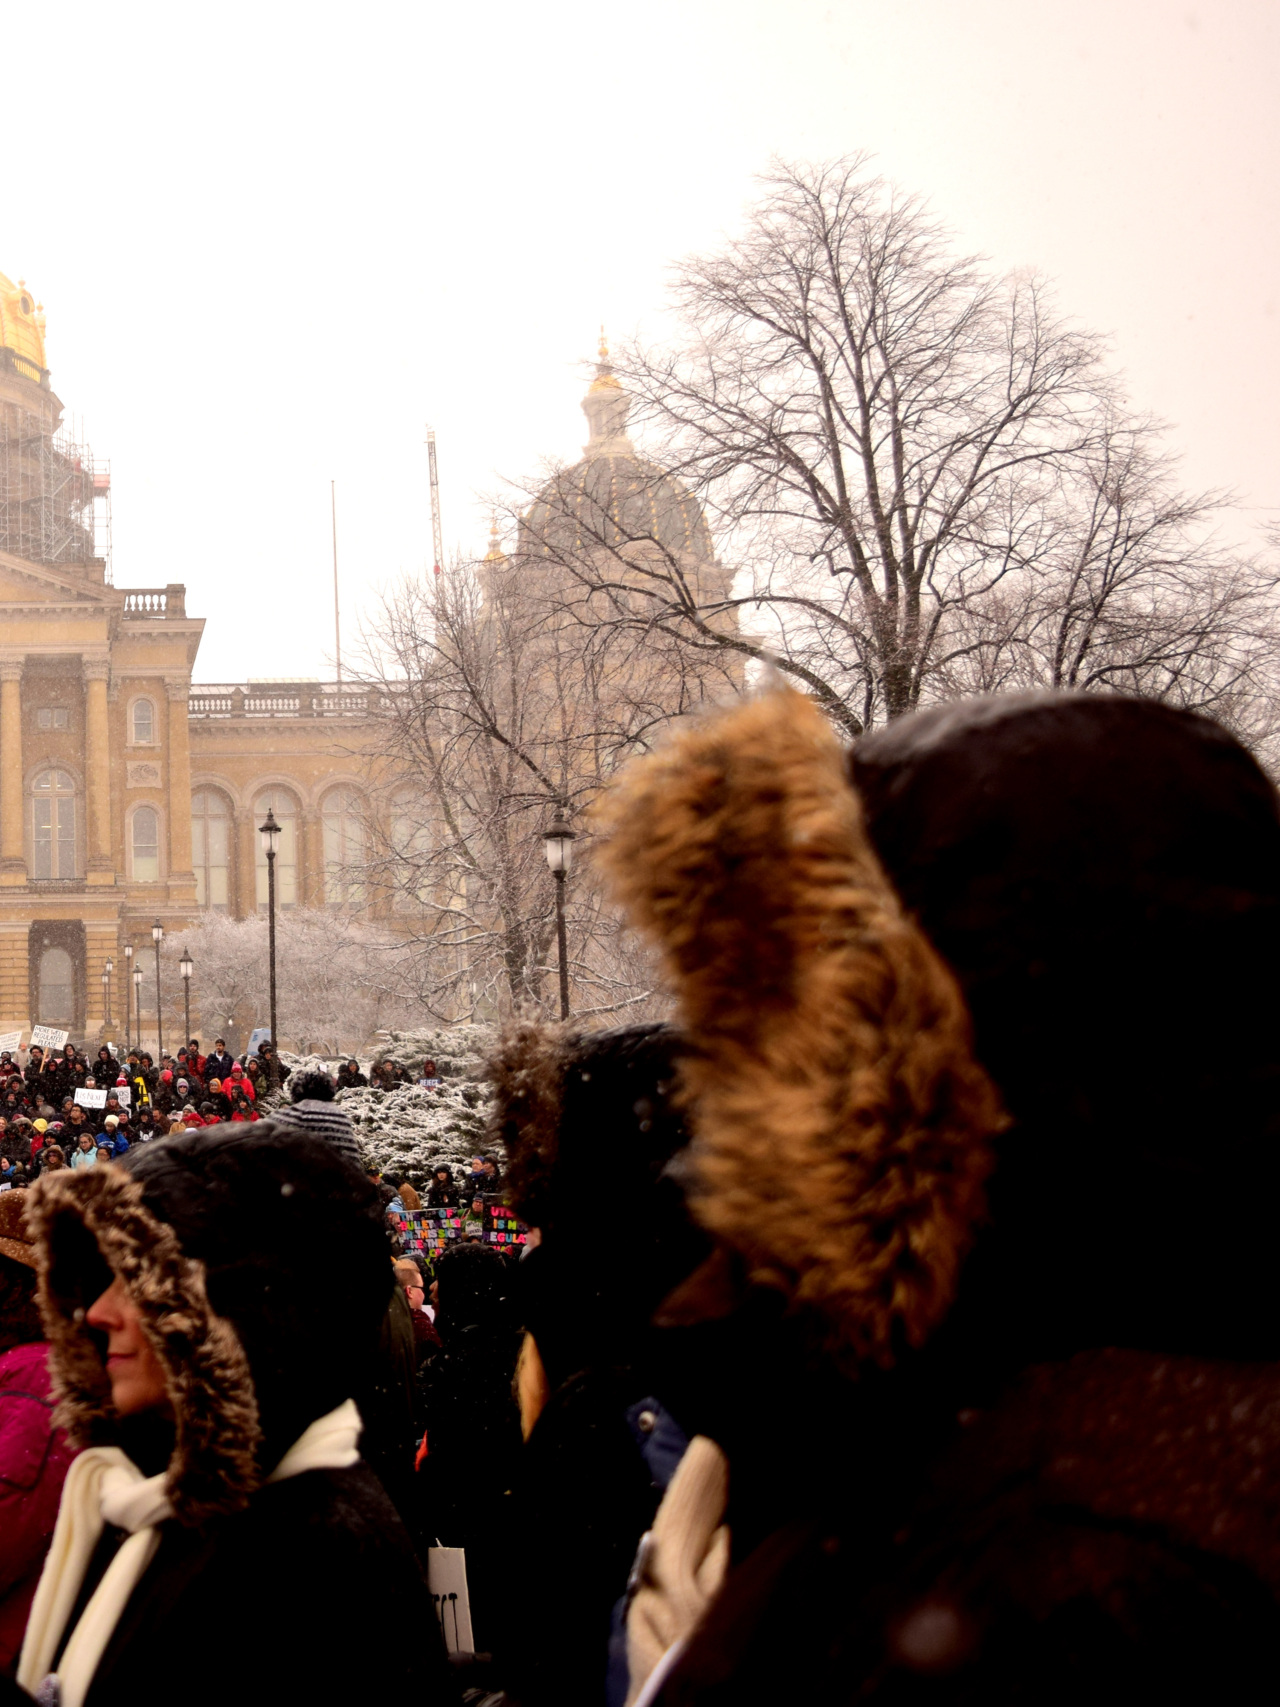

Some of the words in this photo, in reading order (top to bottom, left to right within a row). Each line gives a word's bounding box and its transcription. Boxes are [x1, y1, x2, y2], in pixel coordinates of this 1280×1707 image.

[34, 1032, 64, 1042] REGULATED
[37, 1039, 58, 1048] PLEASE
[438, 1208, 454, 1219] OF
[400, 1219, 434, 1231] BULLET
[493, 1218, 505, 1230] IS
[425, 1238, 445, 1249] THE
